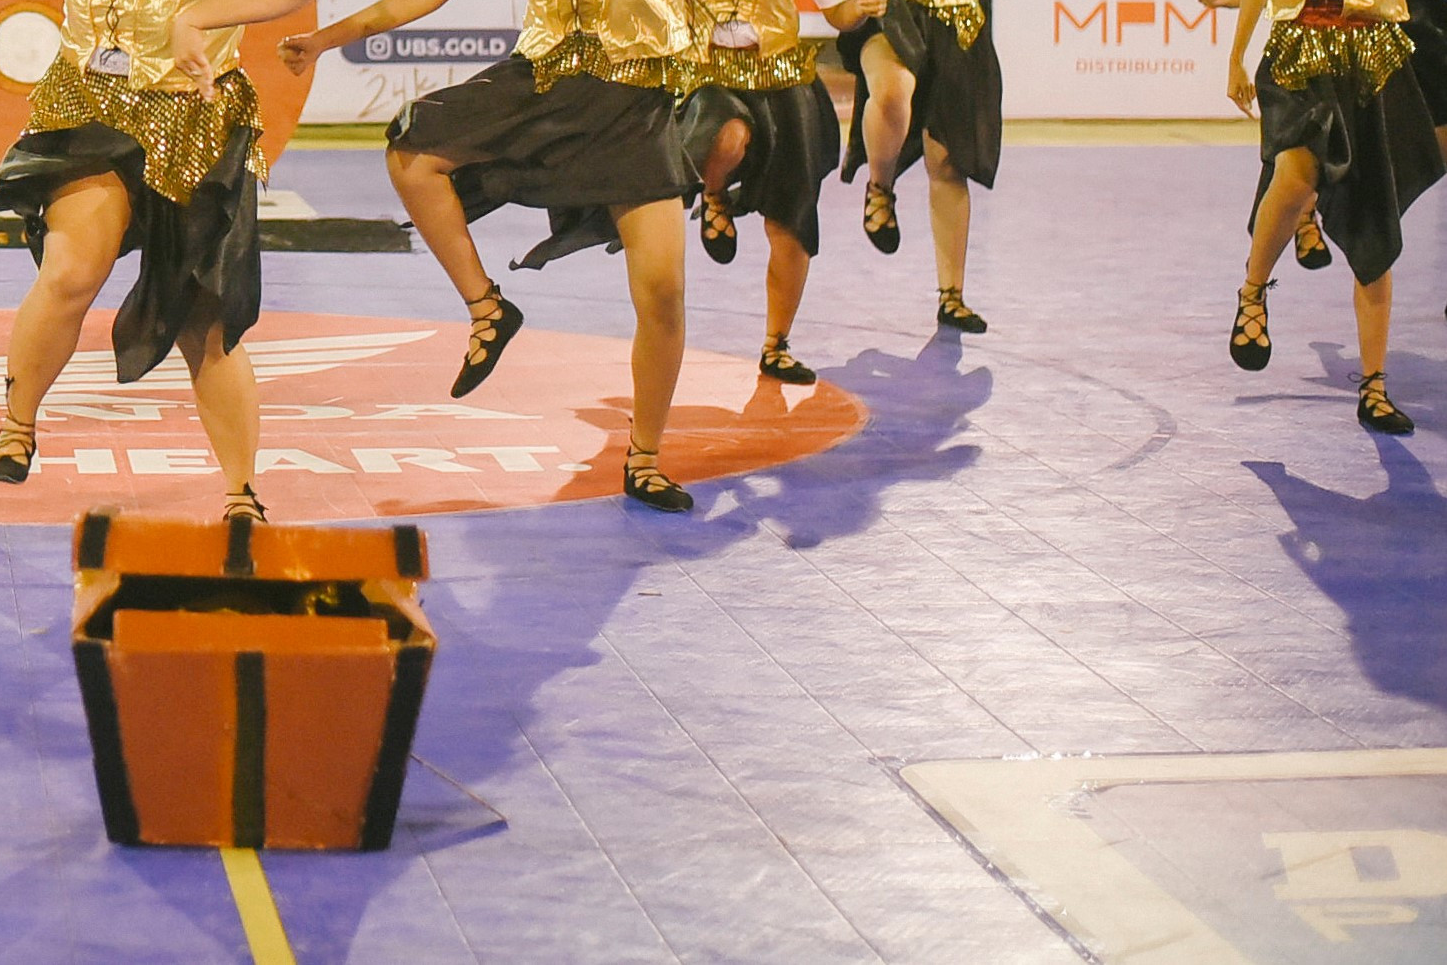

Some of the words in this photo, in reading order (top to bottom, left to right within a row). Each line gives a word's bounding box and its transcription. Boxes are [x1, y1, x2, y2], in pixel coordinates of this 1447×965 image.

[1053, 0, 1217, 46] MPM
[396, 37, 507, 58] UBS.GOLD
[1075, 57, 1196, 75] DISTRIBUTOR
